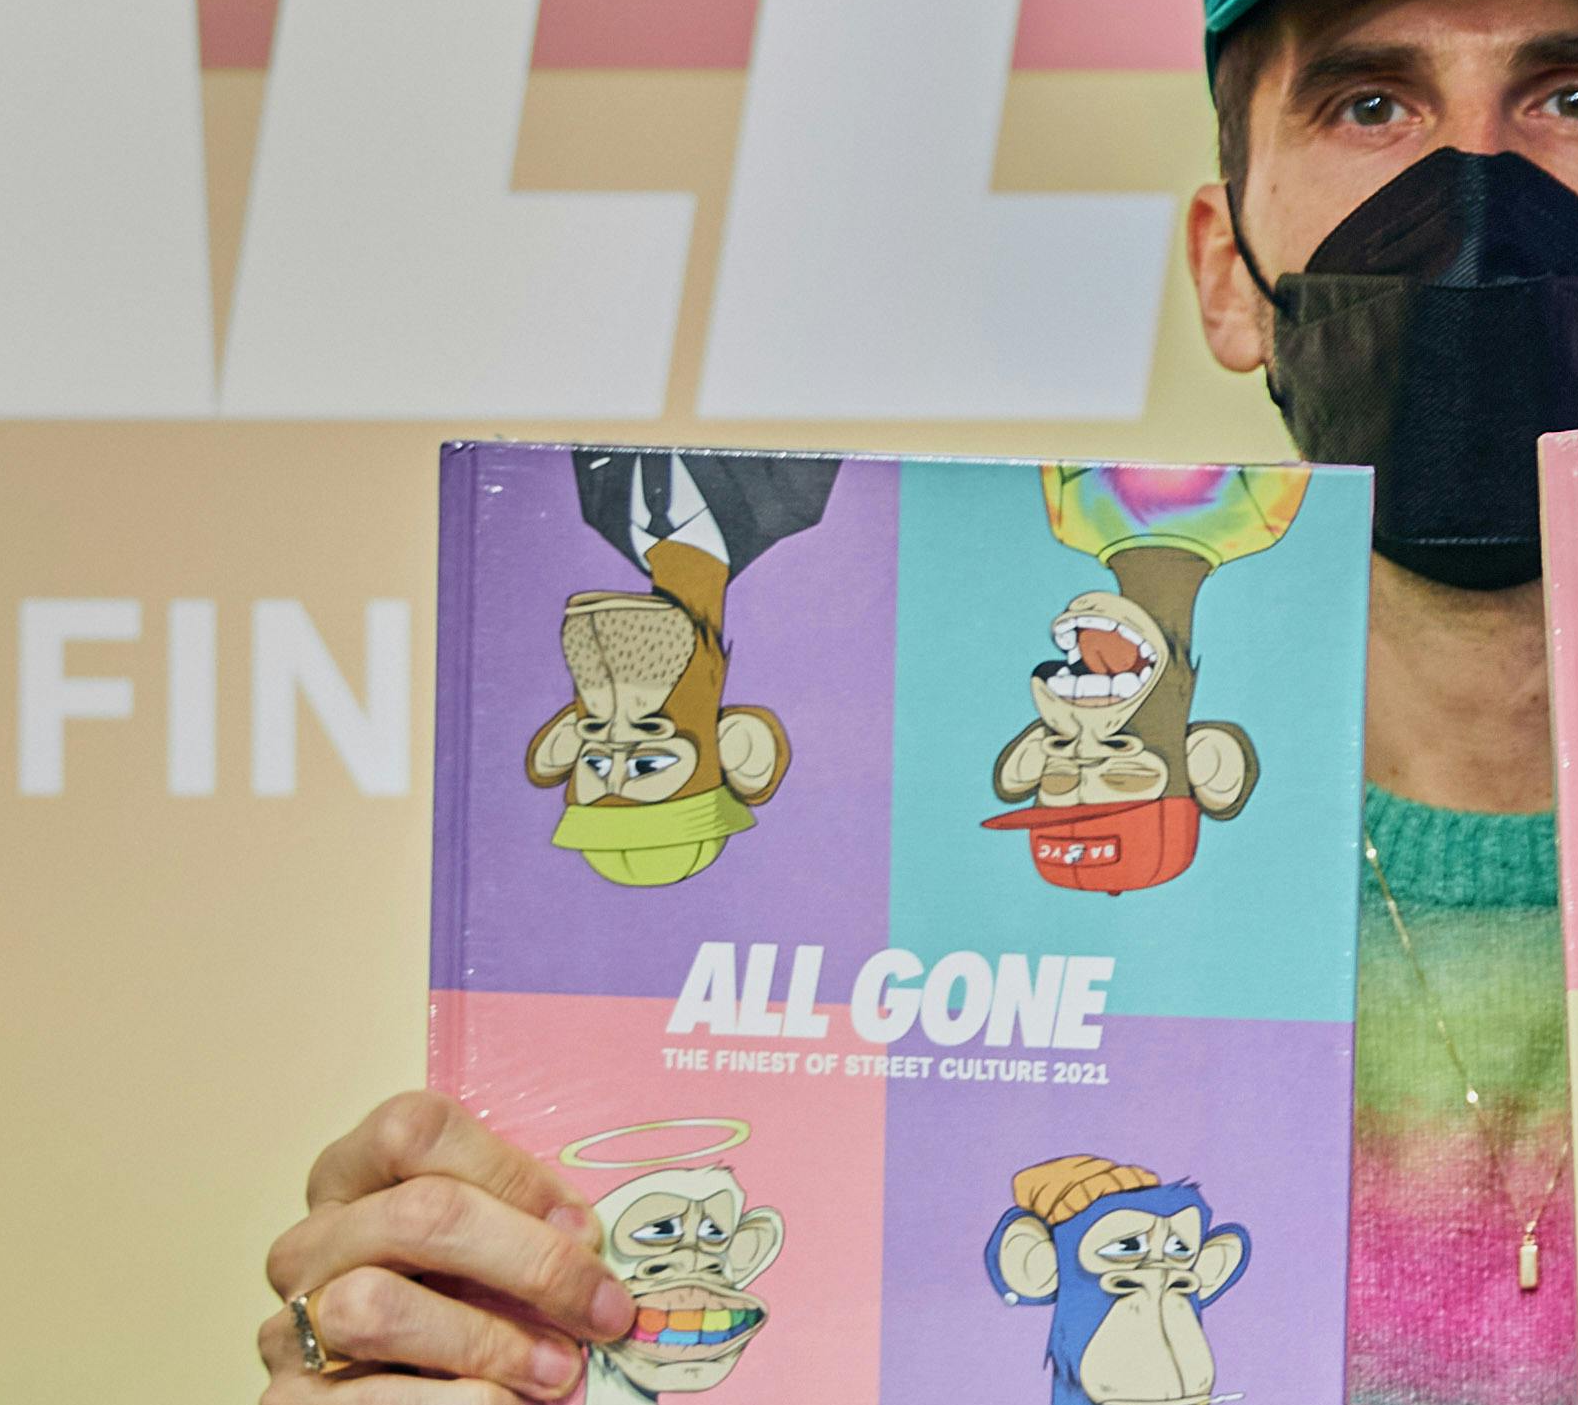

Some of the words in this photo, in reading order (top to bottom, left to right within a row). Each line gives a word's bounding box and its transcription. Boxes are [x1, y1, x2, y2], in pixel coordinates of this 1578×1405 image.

[19, 595, 412, 796] FIN
[666, 941, 829, 1038] ALL
[850, 948, 1115, 1049] GONE
[662, 1048, 709, 1071] THE
[714, 1050, 800, 1074] FINEST
[806, 1052, 837, 1076] OF
[845, 1055, 933, 1079] STREET
[939, 1057, 1047, 1083] CULTURE
[1053, 1061, 1110, 1085] 2021
